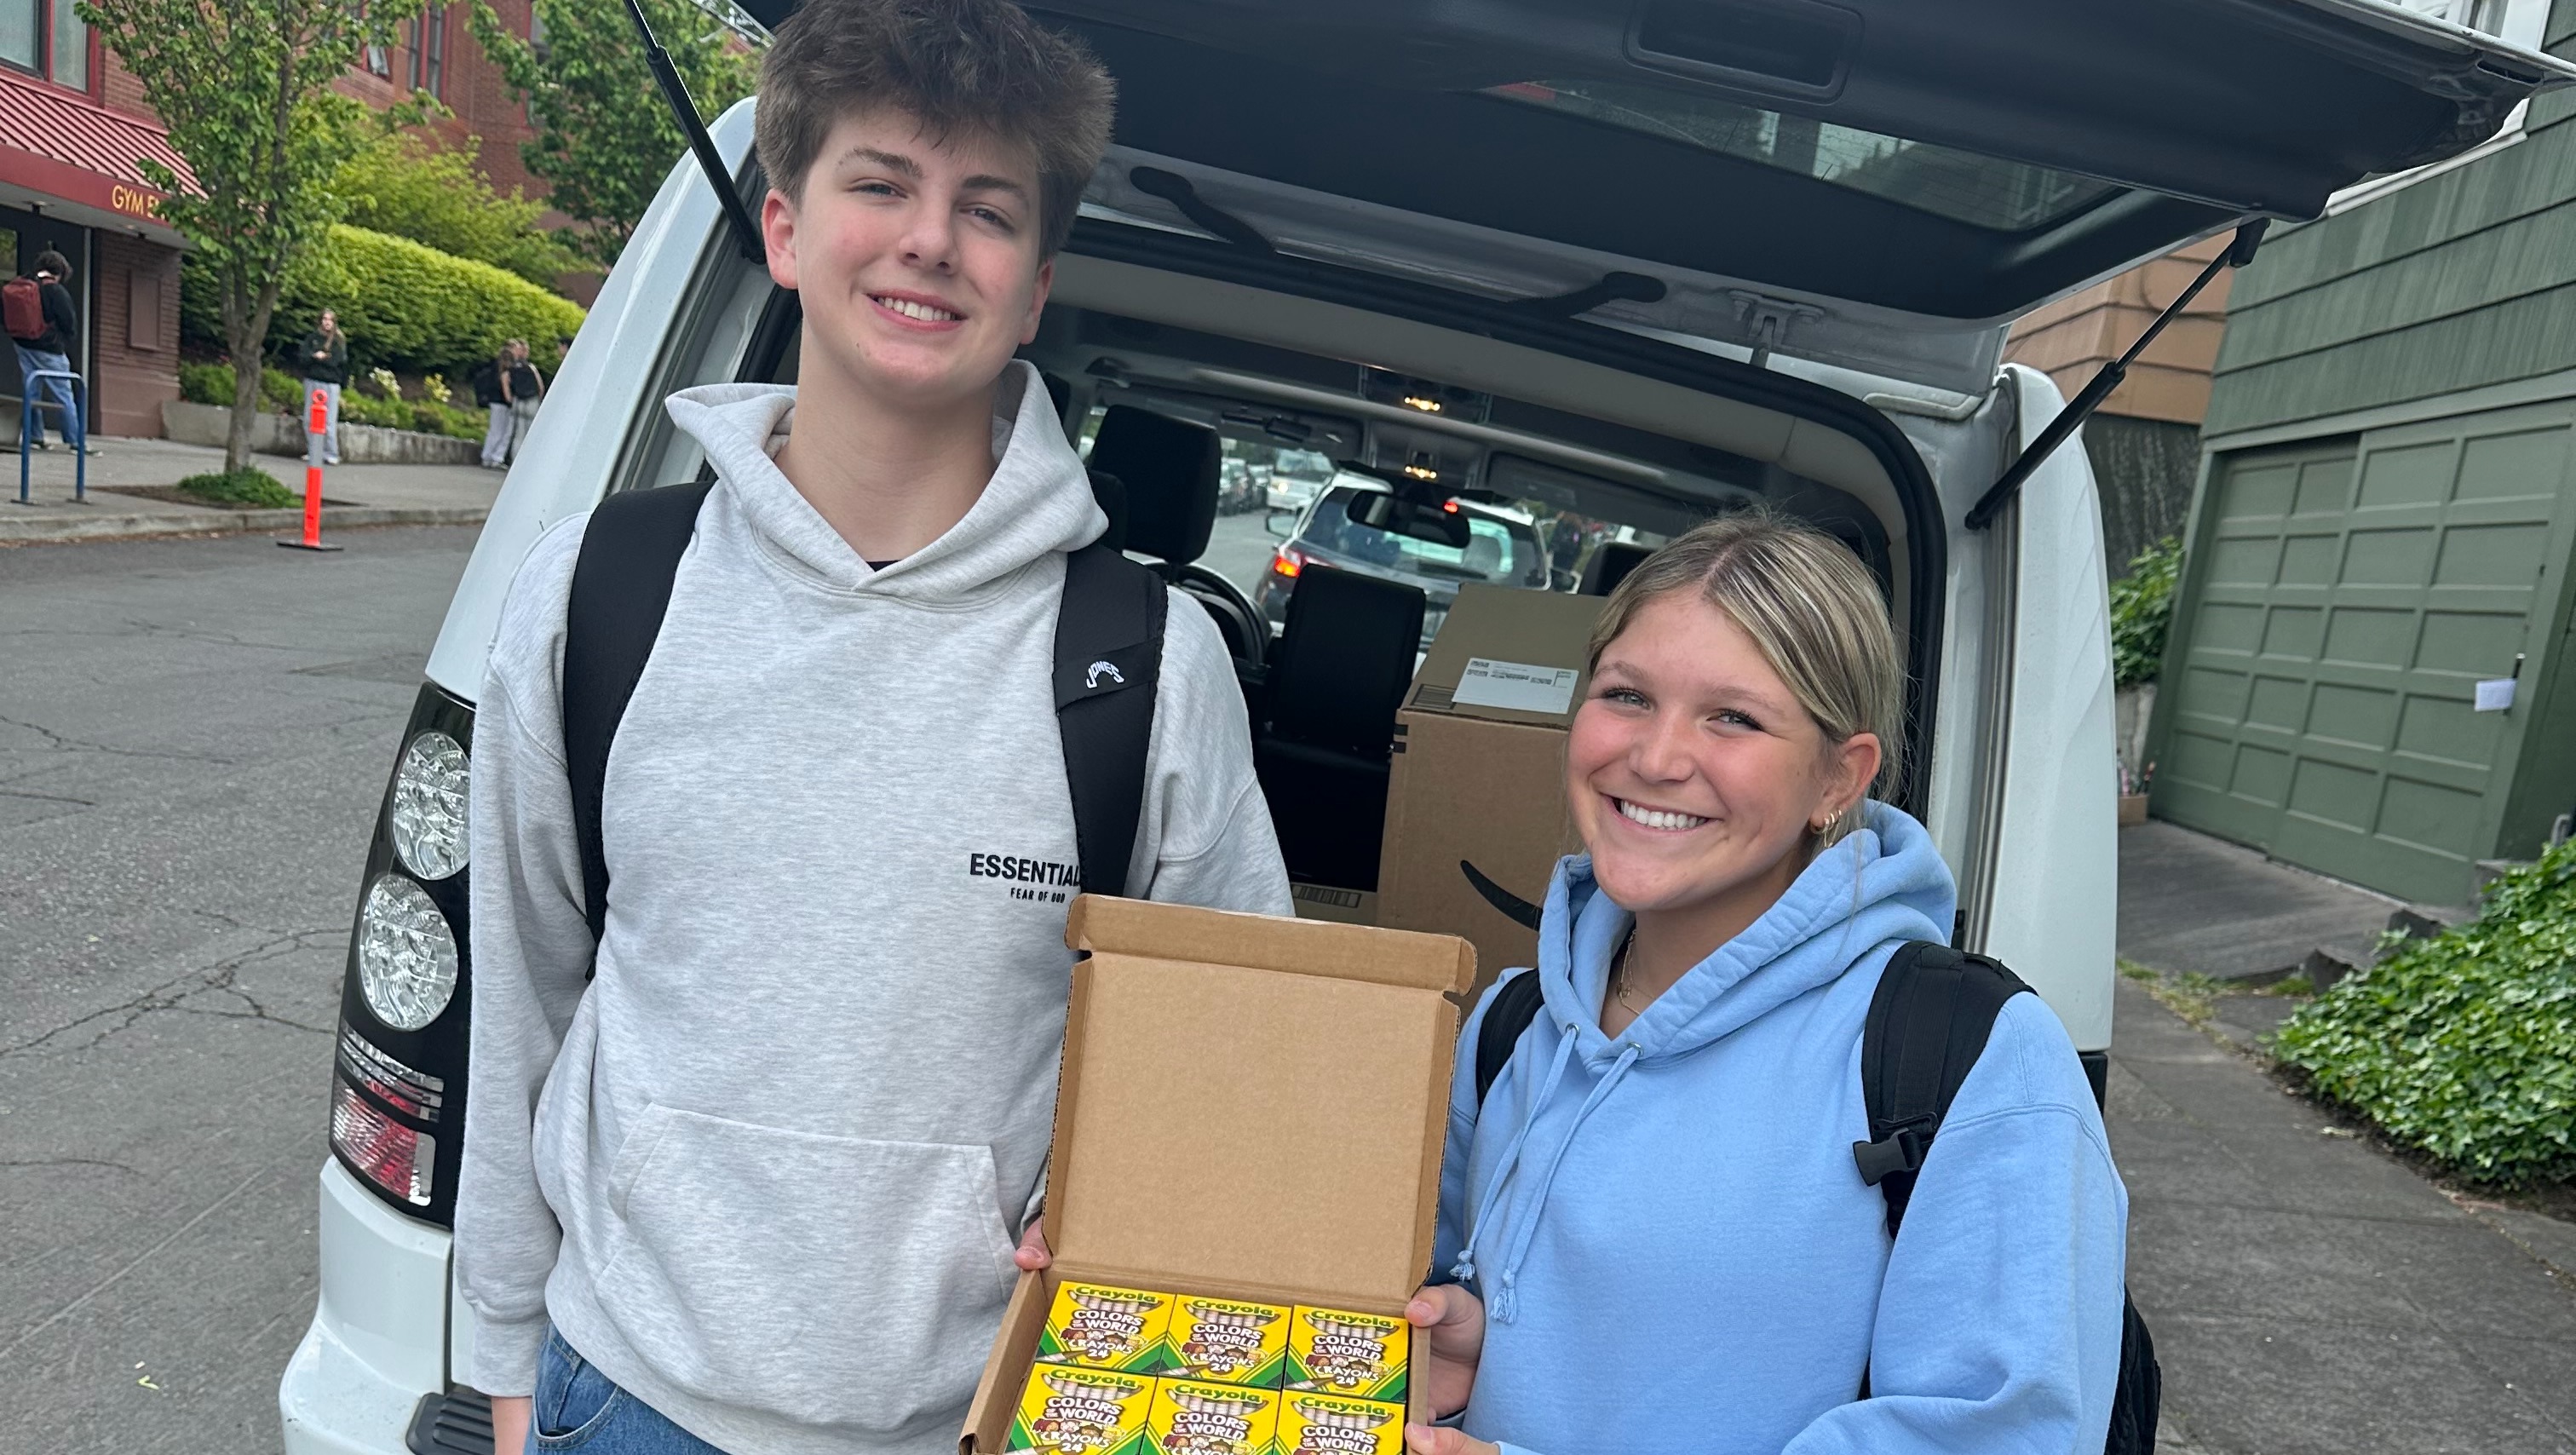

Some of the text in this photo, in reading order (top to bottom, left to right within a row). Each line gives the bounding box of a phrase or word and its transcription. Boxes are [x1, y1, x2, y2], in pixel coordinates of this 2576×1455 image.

[112, 185, 144, 216] GYM
[1086, 660, 1124, 688] JONES
[970, 853, 1081, 887] ESSENTIAL
[1010, 888, 1066, 904] FEAR OF GOD
[1075, 1286, 1157, 1303] Crayola
[1193, 1299, 1274, 1316] Crayola
[1073, 1310, 1144, 1326] COLORS
[1084, 1319, 1141, 1334] WORLD
[1311, 1310, 1392, 1328] Crayola
[1193, 1324, 1263, 1340] COLORS
[1205, 1332, 1260, 1349] WORLD
[1067, 1339, 1134, 1354] CRAYONS
[1314, 1336, 1384, 1352] COLORS
[1327, 1344, 1382, 1360] WORLD
[1087, 1349, 1109, 1359] 24
[1190, 1353, 1256, 1368] CRAYONS
[1210, 1363, 1232, 1372] 24
[1314, 1366, 1379, 1382] CRAYONS
[1050, 1369, 1136, 1388] Crayola
[1336, 1376, 1357, 1386] 24
[1175, 1383, 1262, 1403] Crayola
[1047, 1397, 1123, 1415] COLORS
[1300, 1396, 1386, 1416] Crayola
[1059, 1407, 1118, 1424] WORLD
[1175, 1412, 1251, 1430] COLORS
[1040, 1431, 1111, 1448] CRAYONS
[1187, 1423, 1245, 1441] WORLD
[1302, 1426, 1378, 1445] COLORS
[1061, 1442, 1084, 1453] 24
[1315, 1437, 1375, 1455] WORLD
